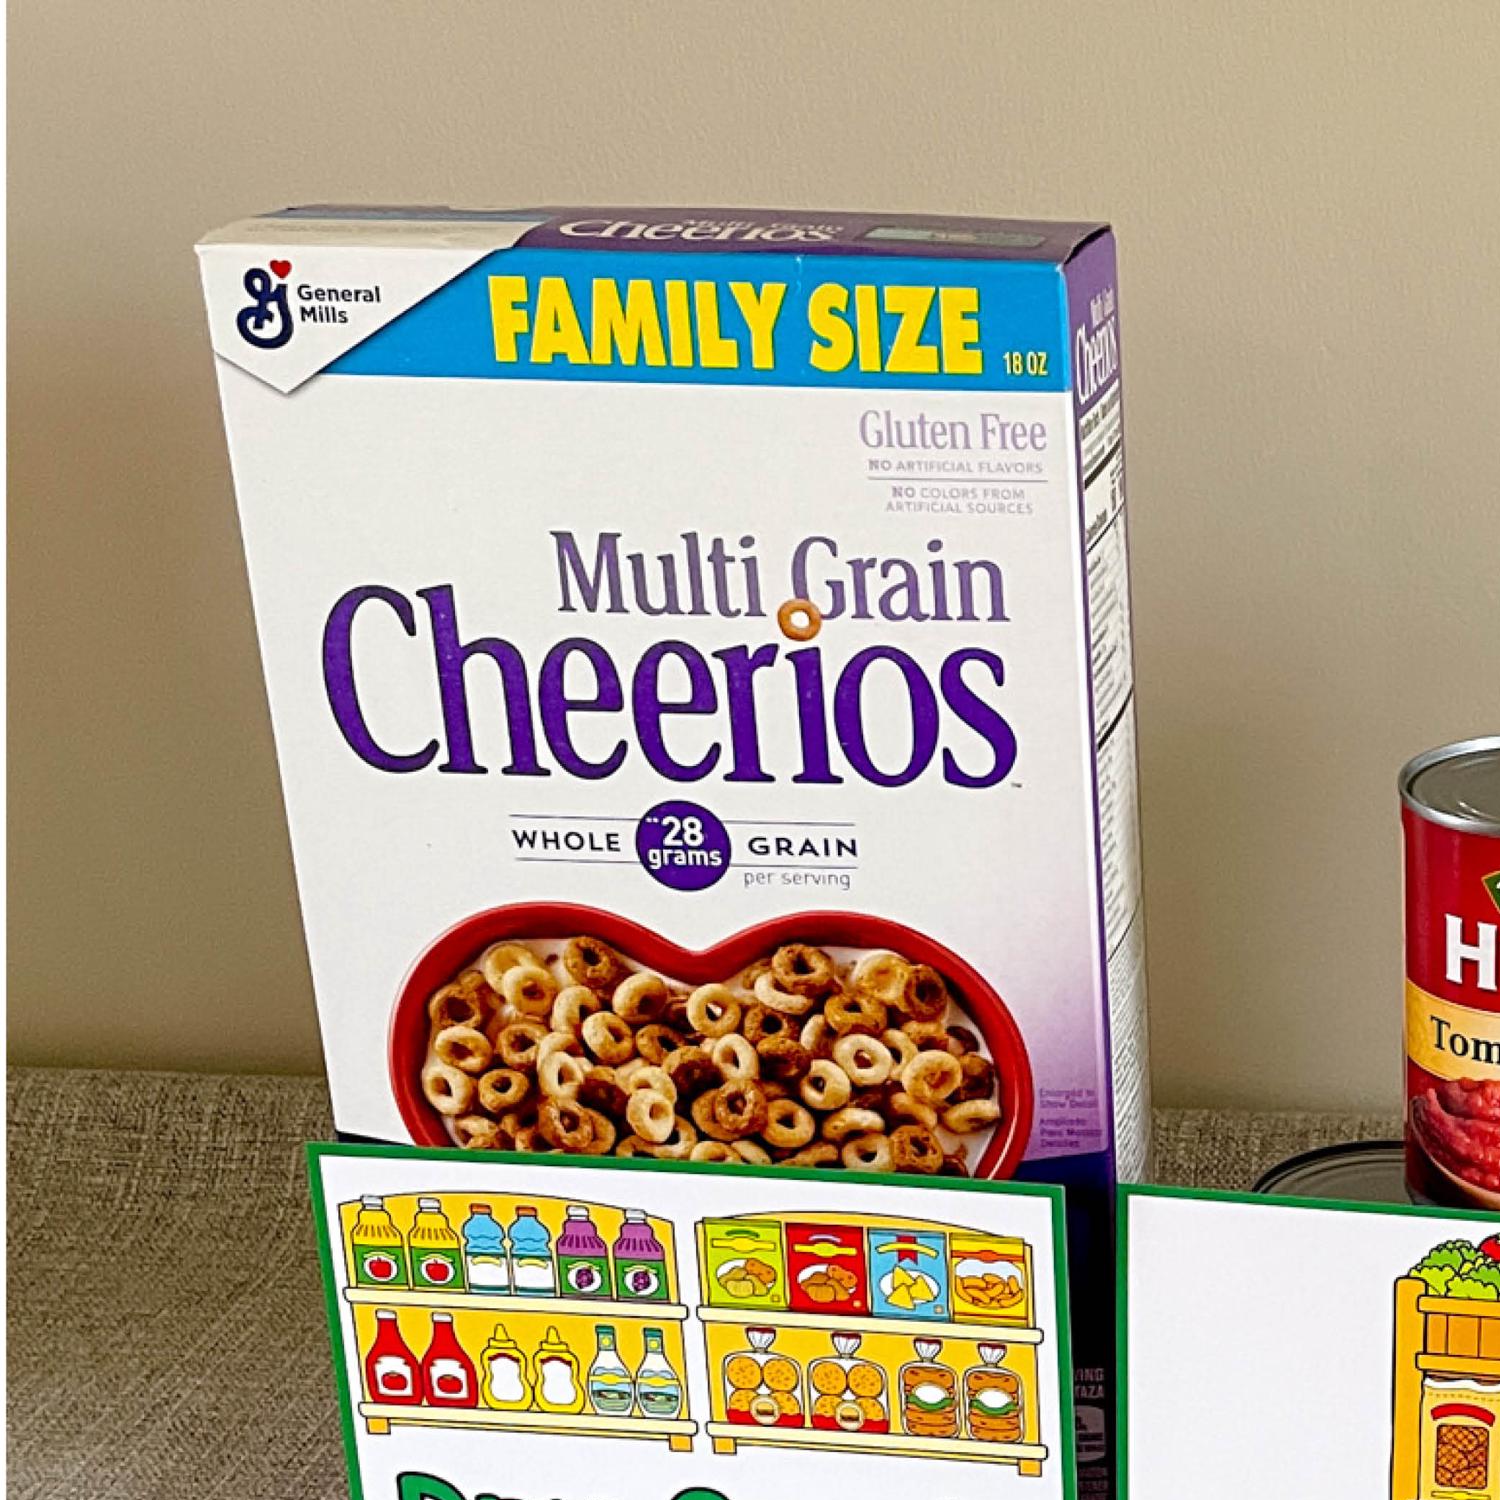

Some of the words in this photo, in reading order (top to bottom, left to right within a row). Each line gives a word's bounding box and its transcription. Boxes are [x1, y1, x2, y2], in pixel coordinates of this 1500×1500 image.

[297, 284, 381, 303] General
[300, 305, 349, 324] Mills
[487, 274, 787, 370] FAMILY
[807, 282, 984, 375] SIZE
[1003, 351, 1023, 376] 18
[1027, 352, 1048, 376] OZ
[859, 409, 972, 450] Gluten
[980, 413, 1048, 451] Free
[868, 459, 892, 472] NO
[895, 460, 974, 474] ARTIFICIAL
[978, 461, 1043, 475] FLAVORS
[891, 485, 916, 499] NO
[920, 487, 978, 500] COLORS
[983, 487, 1026, 500] FROM
[885, 502, 962, 514] ARTIFICIAL
[967, 502, 1034, 515] SOURCES
[549, 530, 767, 618] Multi
[791, 535, 1010, 623] Grain
[322, 583, 1019, 790] Cheerios
[511, 830, 622, 853] WHOLE
[661, 815, 706, 847] 28
[648, 847, 723, 870] grams
[747, 837, 858, 857] GRAIN
[744, 872, 774, 889] per
[781, 871, 851, 890] serving
